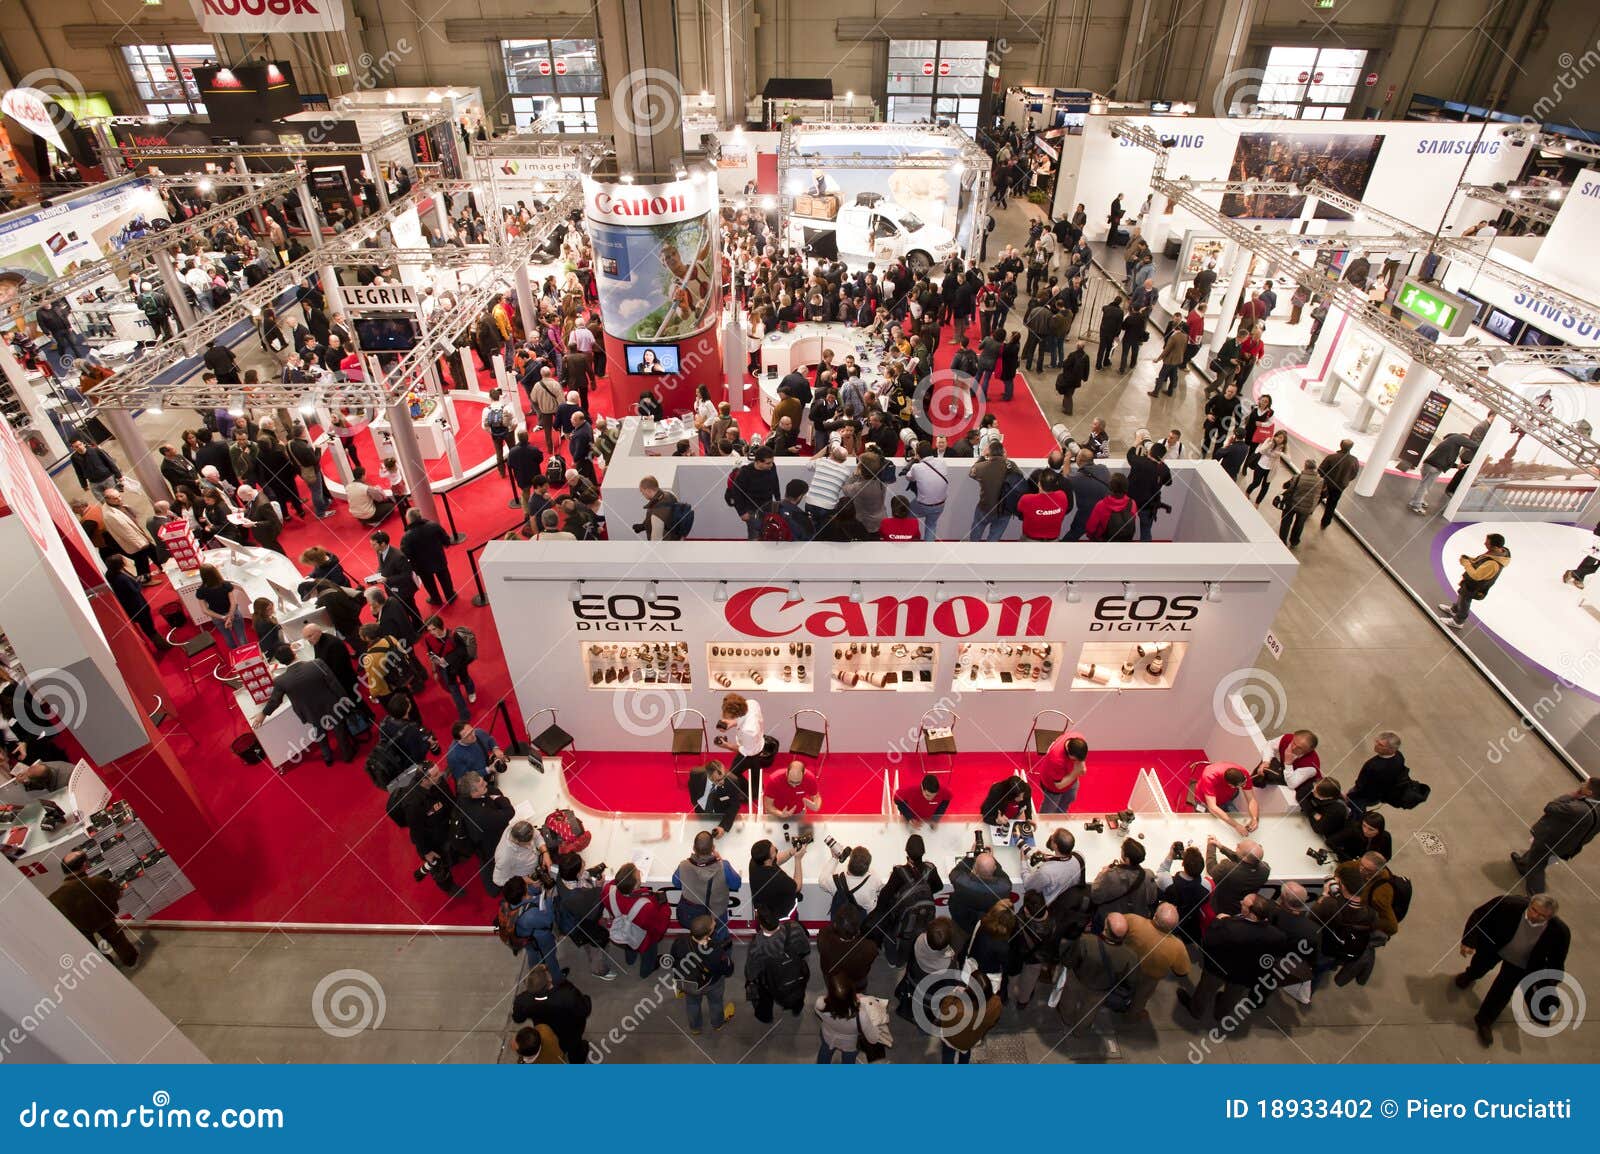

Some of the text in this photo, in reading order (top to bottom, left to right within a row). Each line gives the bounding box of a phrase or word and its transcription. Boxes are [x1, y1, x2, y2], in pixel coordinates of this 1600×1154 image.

[1417, 140, 1500, 155] SAMSUNG
[595, 192, 685, 217] Canon
[343, 287, 413, 305] LEGRIA
[1035, 507, 1062, 516] Canon
[573, 595, 682, 621] EOS
[724, 586, 1053, 638] Canon
[1094, 595, 1204, 621] EOS
[576, 621, 684, 632] DIGITAL
[1089, 621, 1193, 632] DIGITAL
